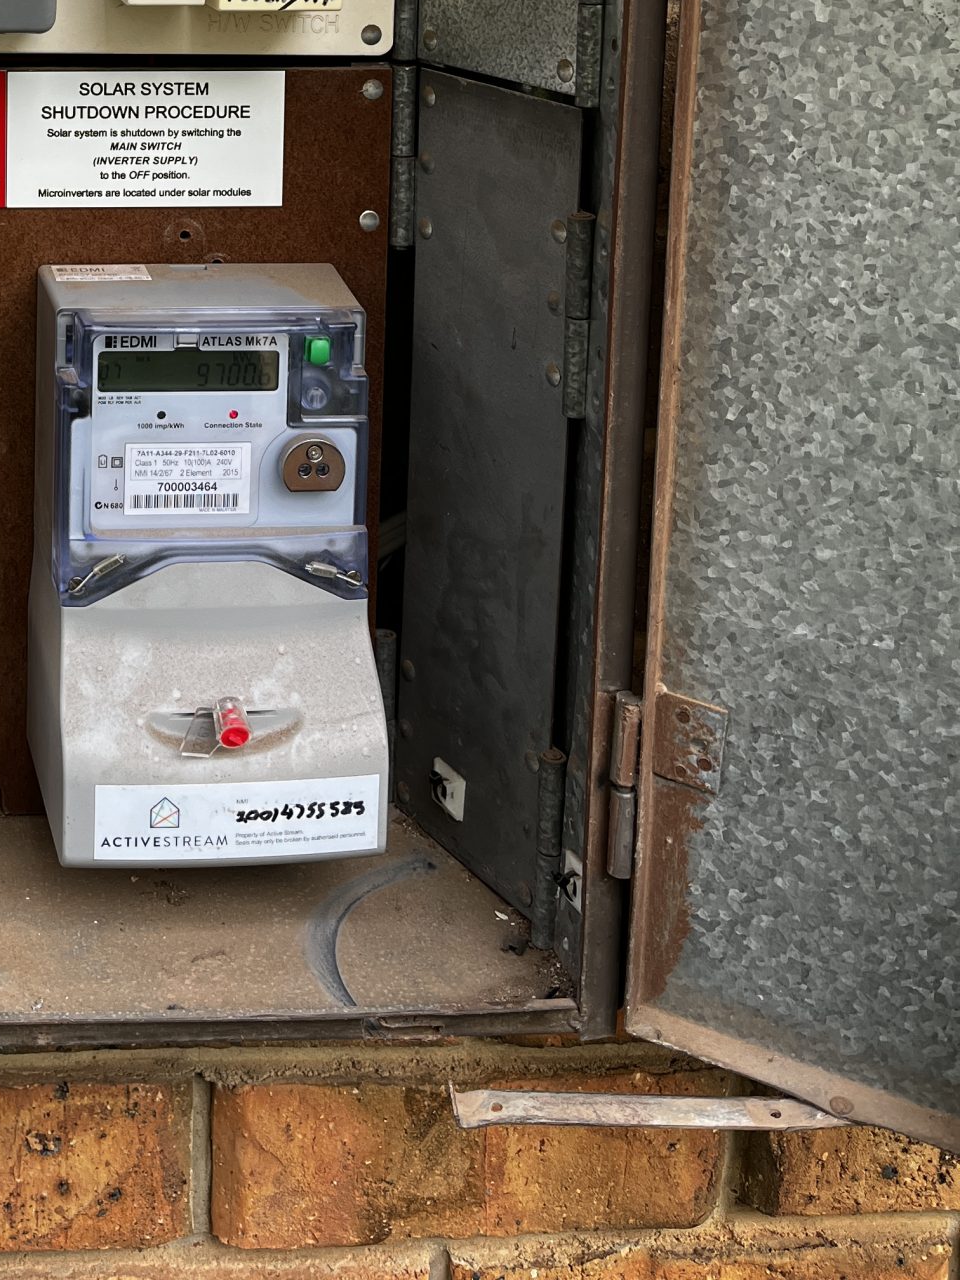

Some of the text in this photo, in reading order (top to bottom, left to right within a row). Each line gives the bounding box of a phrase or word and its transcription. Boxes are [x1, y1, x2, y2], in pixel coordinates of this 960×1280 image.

[207, 13, 340, 34] H/W SWITCH
[79, 82, 209, 96] SOLAR SYSTEM
[41, 105, 251, 119] SHUTDOWN PROCEDURE
[46, 127, 242, 140] Solar system is shutdown by switching the
[109, 142, 182, 151] MAIN SWITCH
[93, 156, 199, 167] (INVERTER SUPPLY)
[100, 170, 191, 181] to the OFF position.
[38, 188, 103, 198] Microinverters
[122, 188, 157, 197] located
[158, 188, 186, 197] under
[187, 188, 211, 197] solar
[212, 187, 252, 197] modules
[120, 335, 277, 348] EDMI ATLAS Mk7A
[154, 422, 185, 431] imp/kWh
[245, 421, 263, 429] State
[185, 469, 212, 477] Element
[157, 482, 218, 492] 700003464
